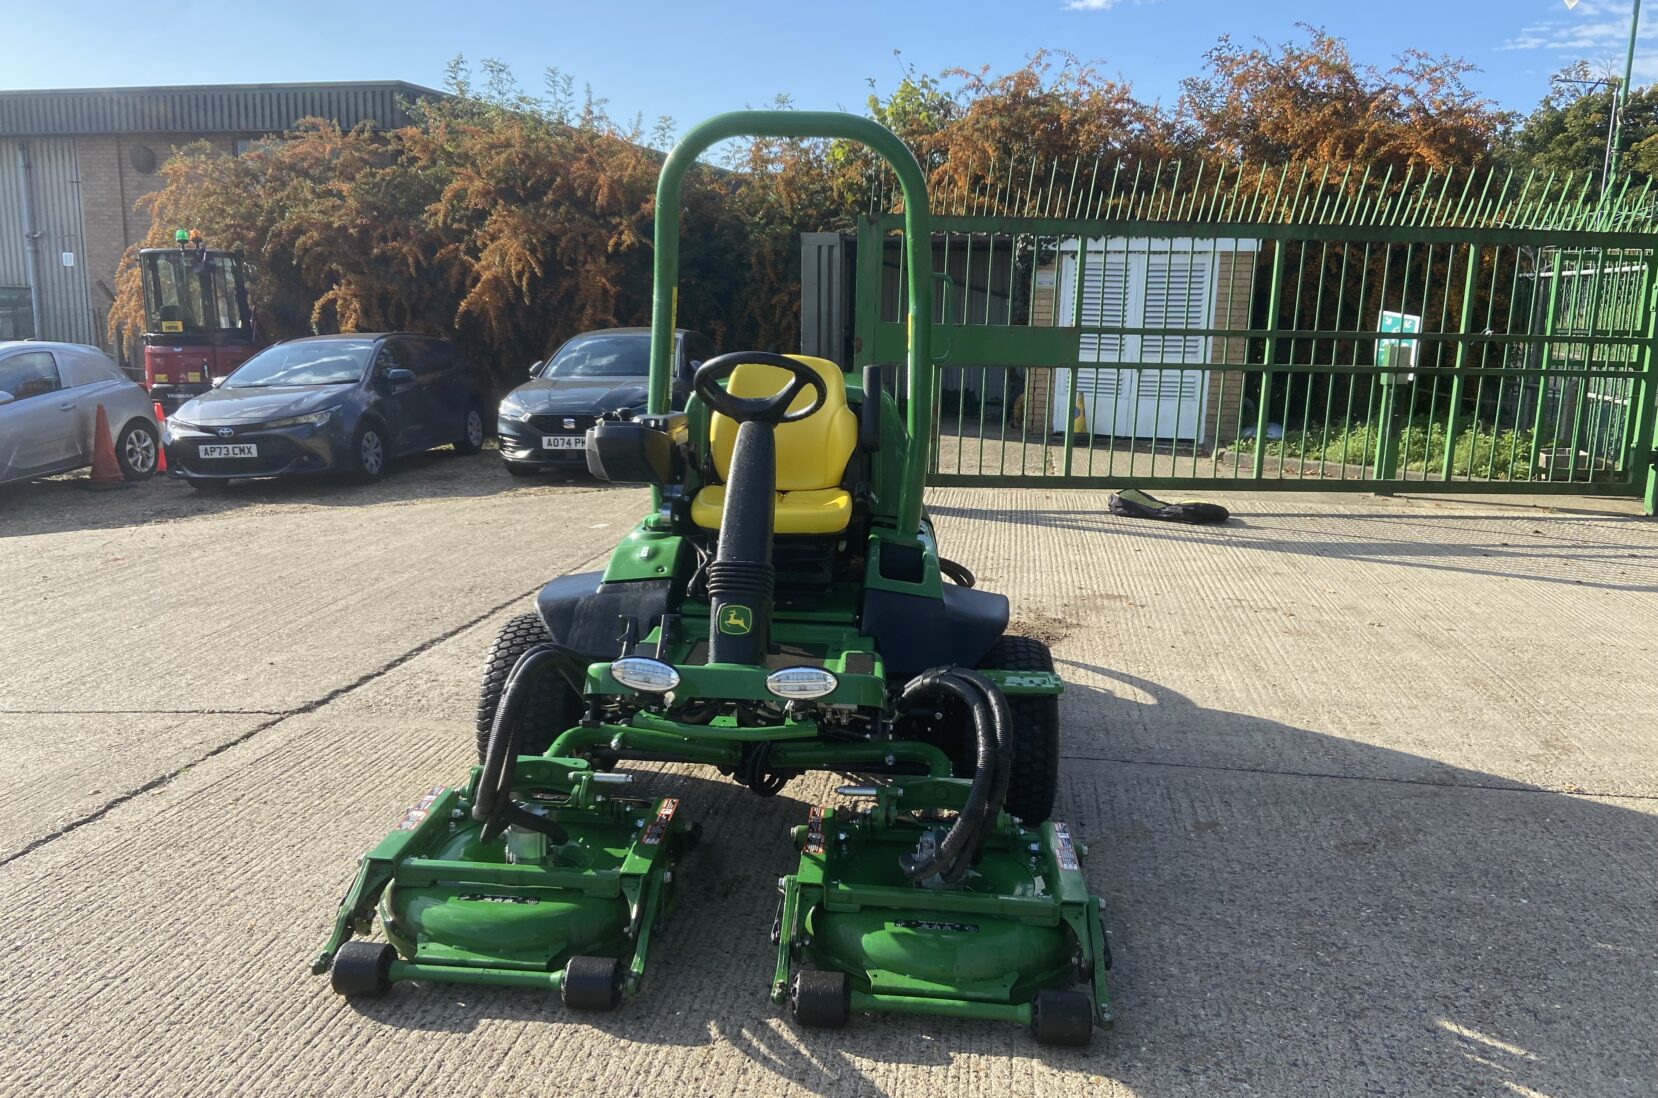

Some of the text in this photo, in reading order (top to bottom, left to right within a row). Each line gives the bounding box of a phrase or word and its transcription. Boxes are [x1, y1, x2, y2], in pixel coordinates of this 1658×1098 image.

[574, 438, 586, 447] PK
[204, 446, 253, 457] AP73 CMX
